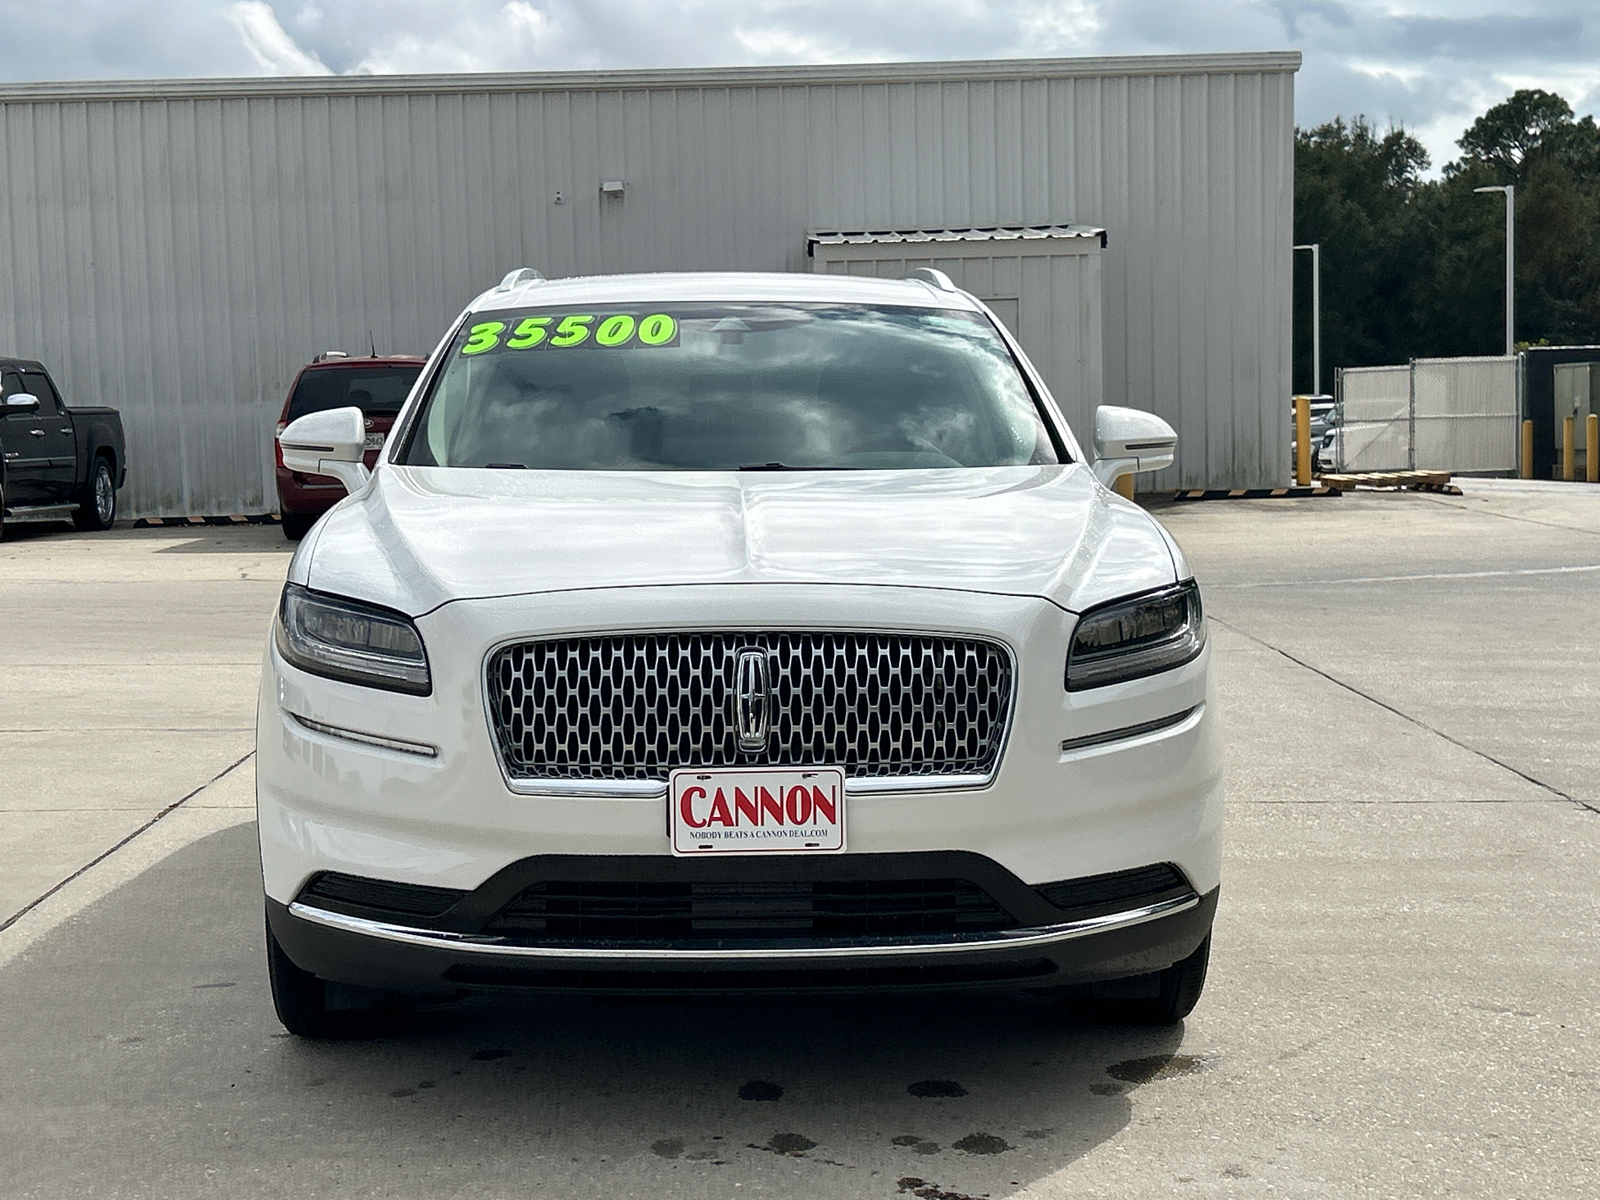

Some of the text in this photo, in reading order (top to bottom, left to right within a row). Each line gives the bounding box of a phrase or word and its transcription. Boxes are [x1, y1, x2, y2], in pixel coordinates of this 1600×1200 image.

[461, 314, 678, 355] 35500
[680, 785, 837, 828] CANNON
[689, 829, 829, 840] NOBODY BEATS A CANNON DEAL.COM
